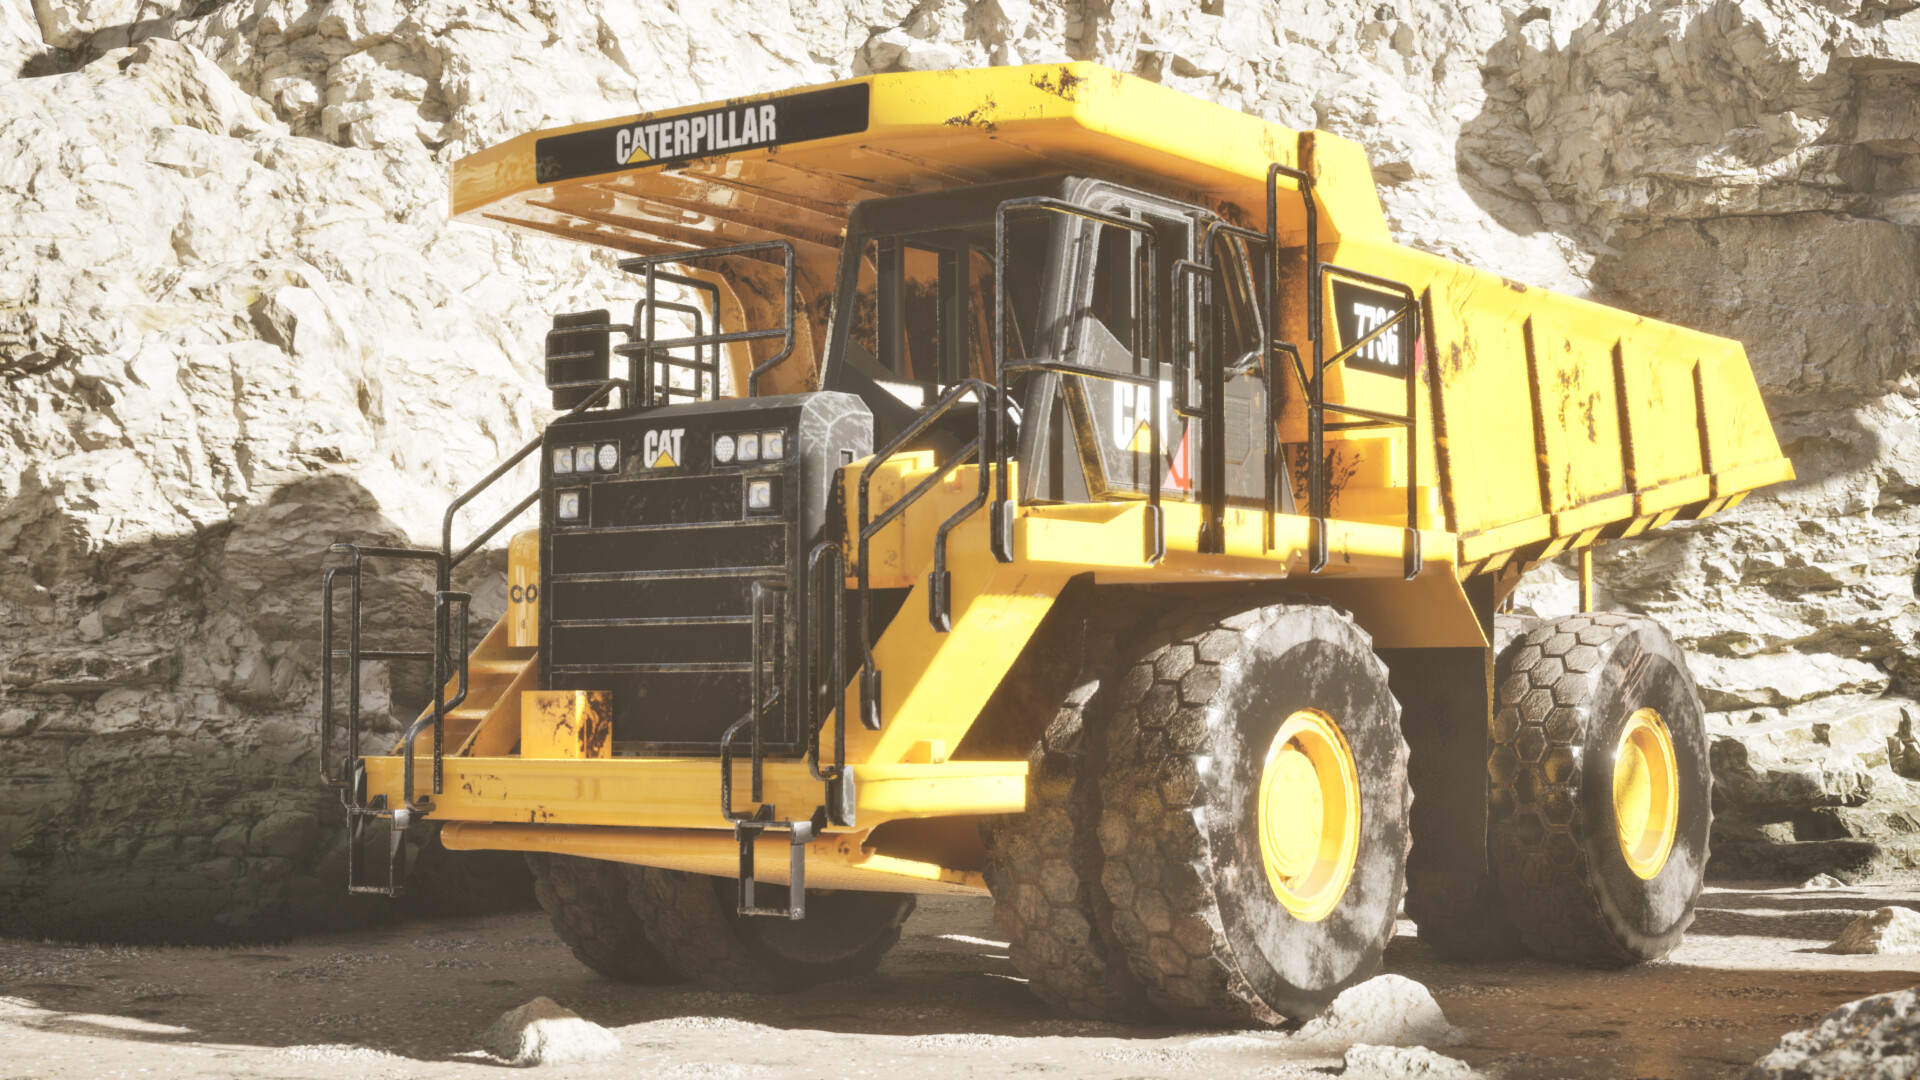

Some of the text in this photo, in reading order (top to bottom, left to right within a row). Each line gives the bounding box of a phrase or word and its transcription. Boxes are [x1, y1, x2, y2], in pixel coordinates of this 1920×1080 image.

[615, 104, 777, 166] CATERPILLAR
[643, 428, 685, 469] CAT
[1113, 379, 1172, 456] CAT
